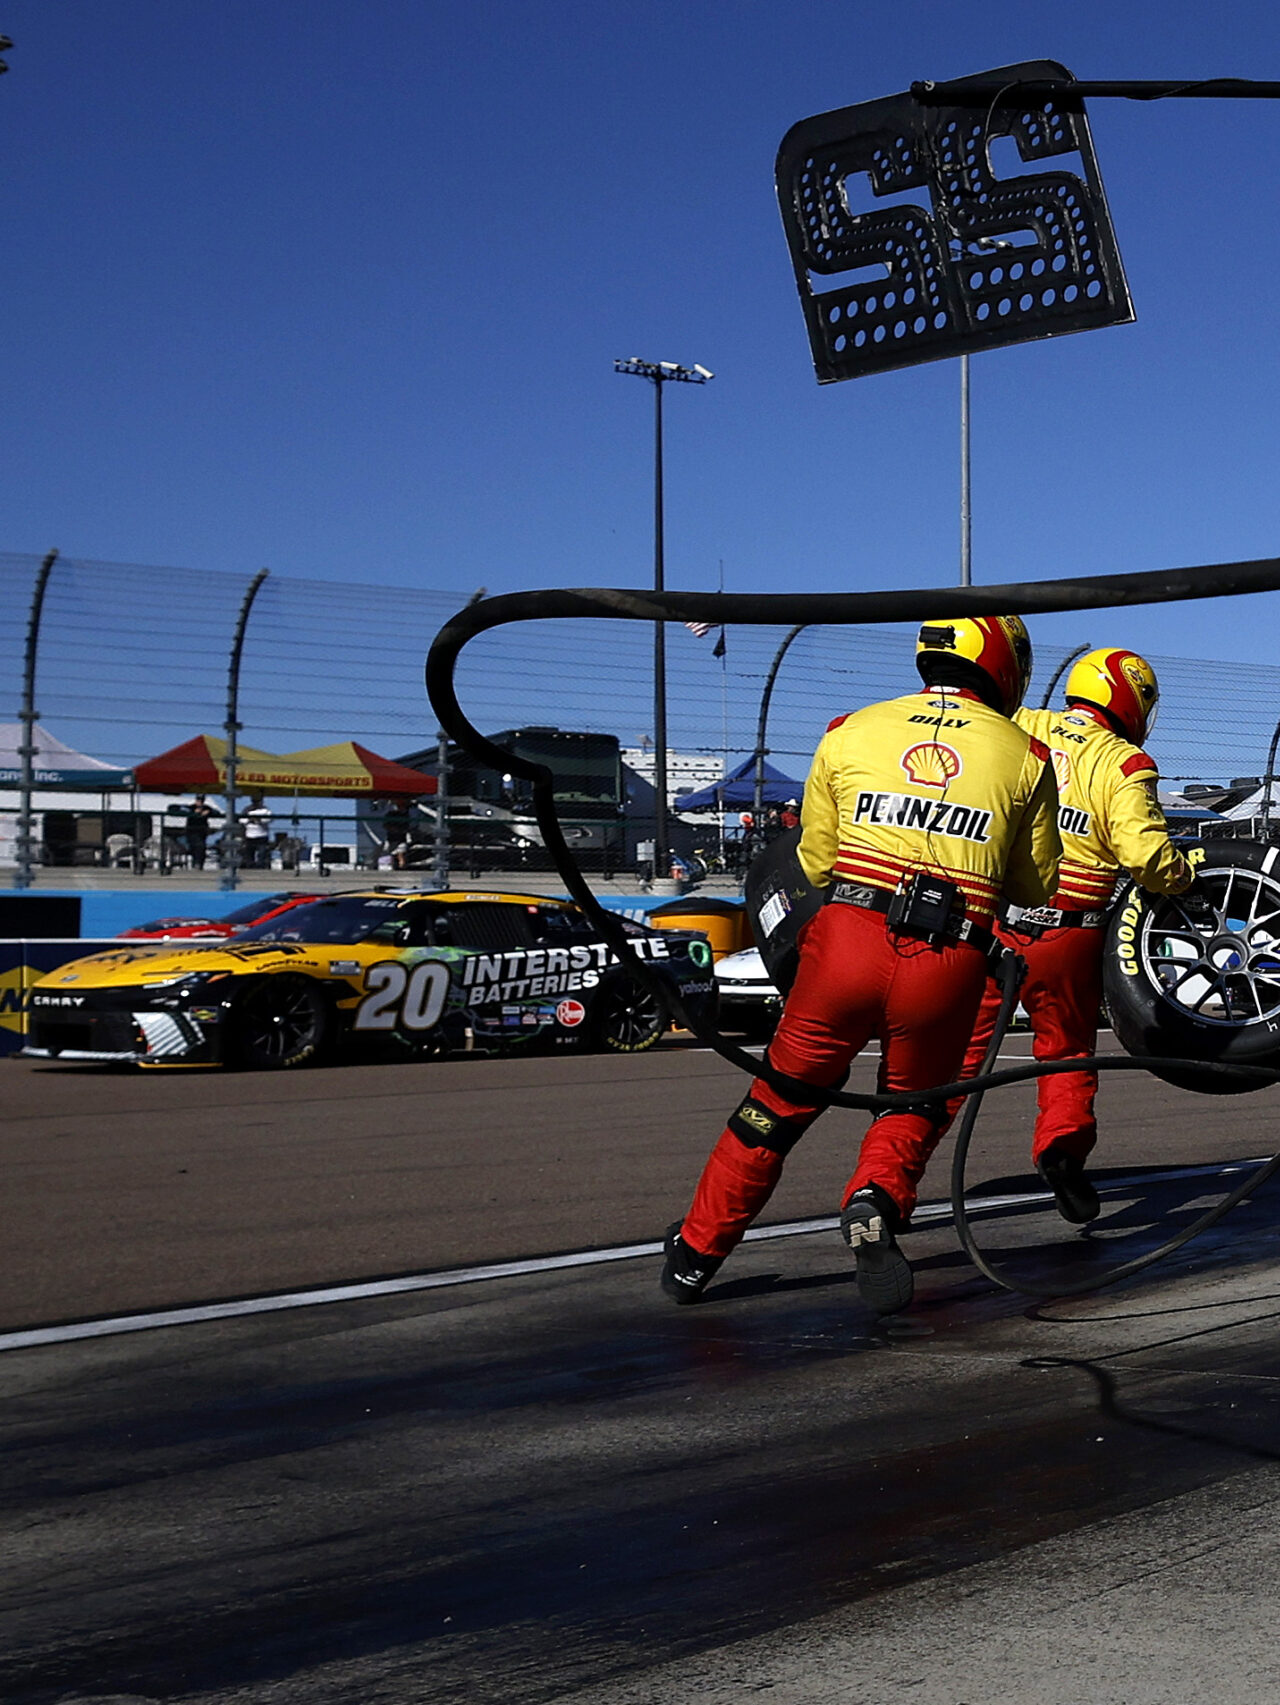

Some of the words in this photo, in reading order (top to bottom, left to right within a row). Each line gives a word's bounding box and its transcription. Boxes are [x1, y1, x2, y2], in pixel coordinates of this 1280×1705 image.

[854, 792, 992, 841] PENNZOIL
[1058, 807, 1091, 836] OIL
[1117, 848, 1207, 976] GOODYR
[462, 936, 671, 986] INTERSTTE
[33, 995, 86, 1007] CAMRY
[352, 959, 451, 1032] 20
[467, 968, 601, 1007] BATTERIES
